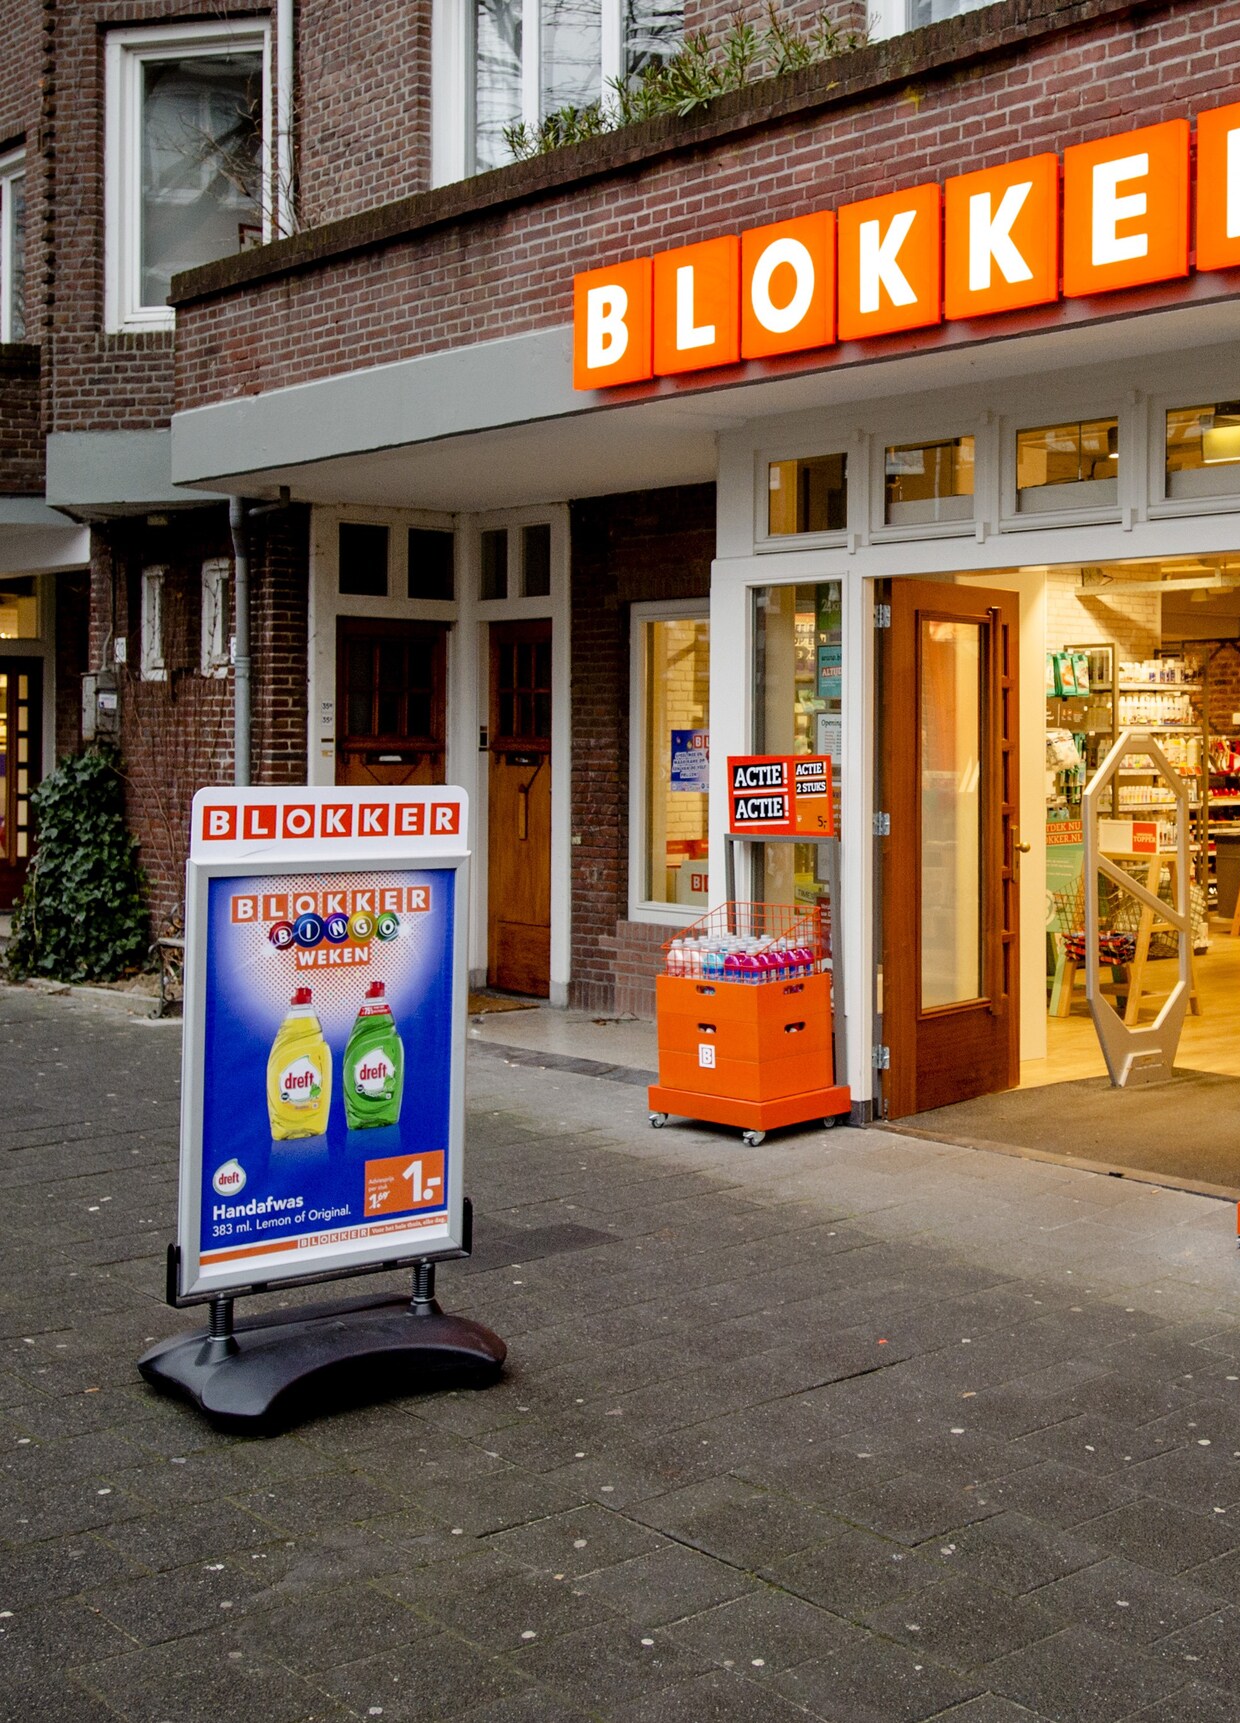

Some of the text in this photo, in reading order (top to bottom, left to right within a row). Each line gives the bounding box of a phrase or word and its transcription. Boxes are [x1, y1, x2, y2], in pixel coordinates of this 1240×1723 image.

[734, 762, 788, 787] ACTIE!
[796, 761, 826, 775] ACTIE!
[796, 781, 826, 793] 2 STUKS
[736, 795, 789, 819] ACTIE!
[209, 802, 453, 836] BLOKKER
[1068, 821, 1081, 831] NU
[237, 889, 426, 919] BLOKKER
[275, 916, 396, 946] BINGO
[298, 946, 369, 966] WEKEN
[285, 1071, 314, 1090] dreft
[360, 1063, 387, 1081] dreft
[218, 1172, 239, 1186] dreft
[213, 1195, 304, 1221] Handafwas
[212, 1204, 351, 1237] 383 ml. Lemon of Original.
[301, 1228, 368, 1248] BLOKKER
